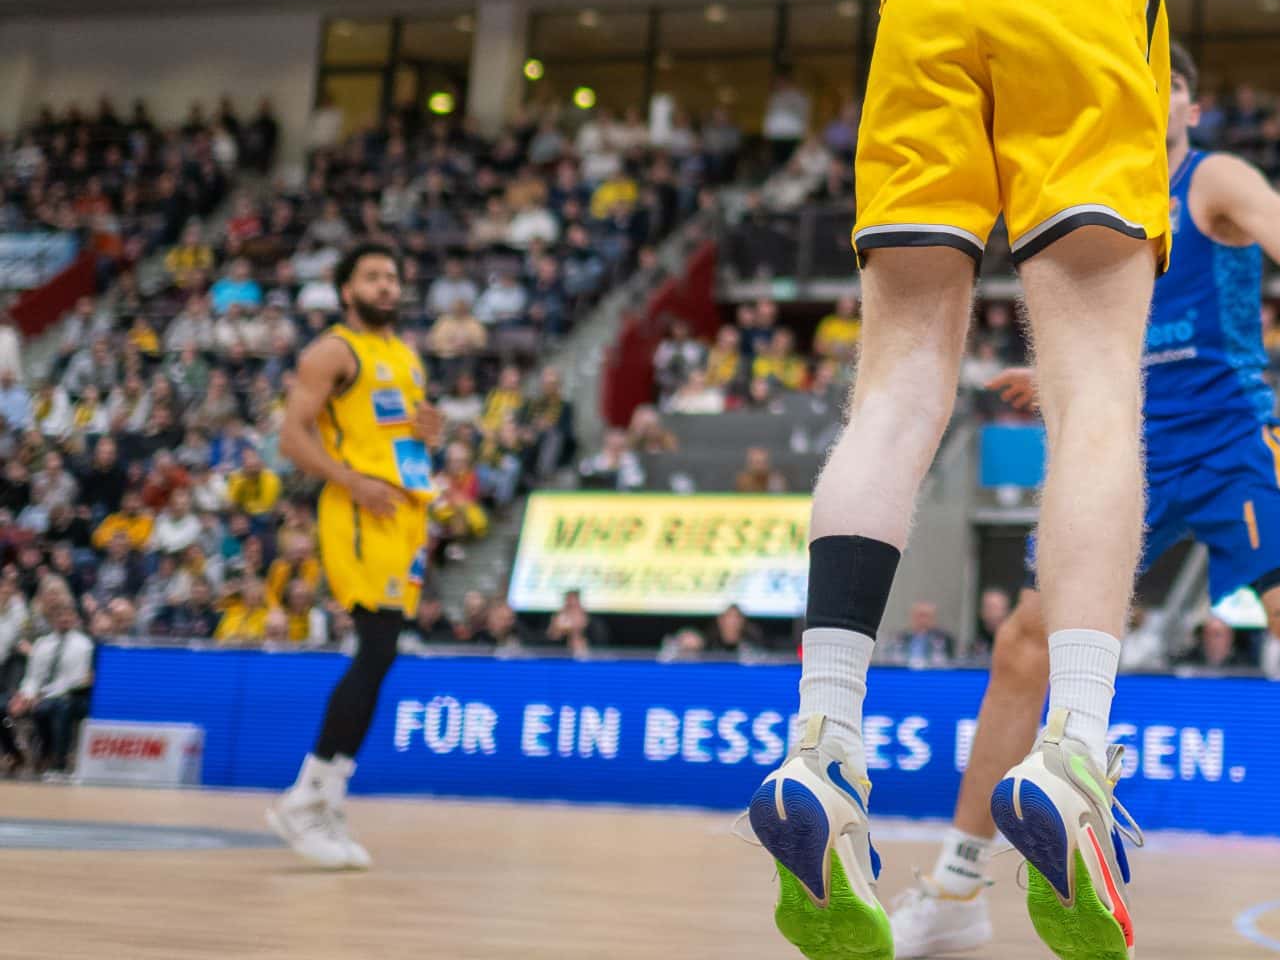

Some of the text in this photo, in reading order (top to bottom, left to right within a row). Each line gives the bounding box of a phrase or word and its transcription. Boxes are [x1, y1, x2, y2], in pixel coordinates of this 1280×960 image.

[395, 695, 498, 755] FÜR
[522, 703, 620, 760] EIN
[644, 707, 931, 770] BESSES
